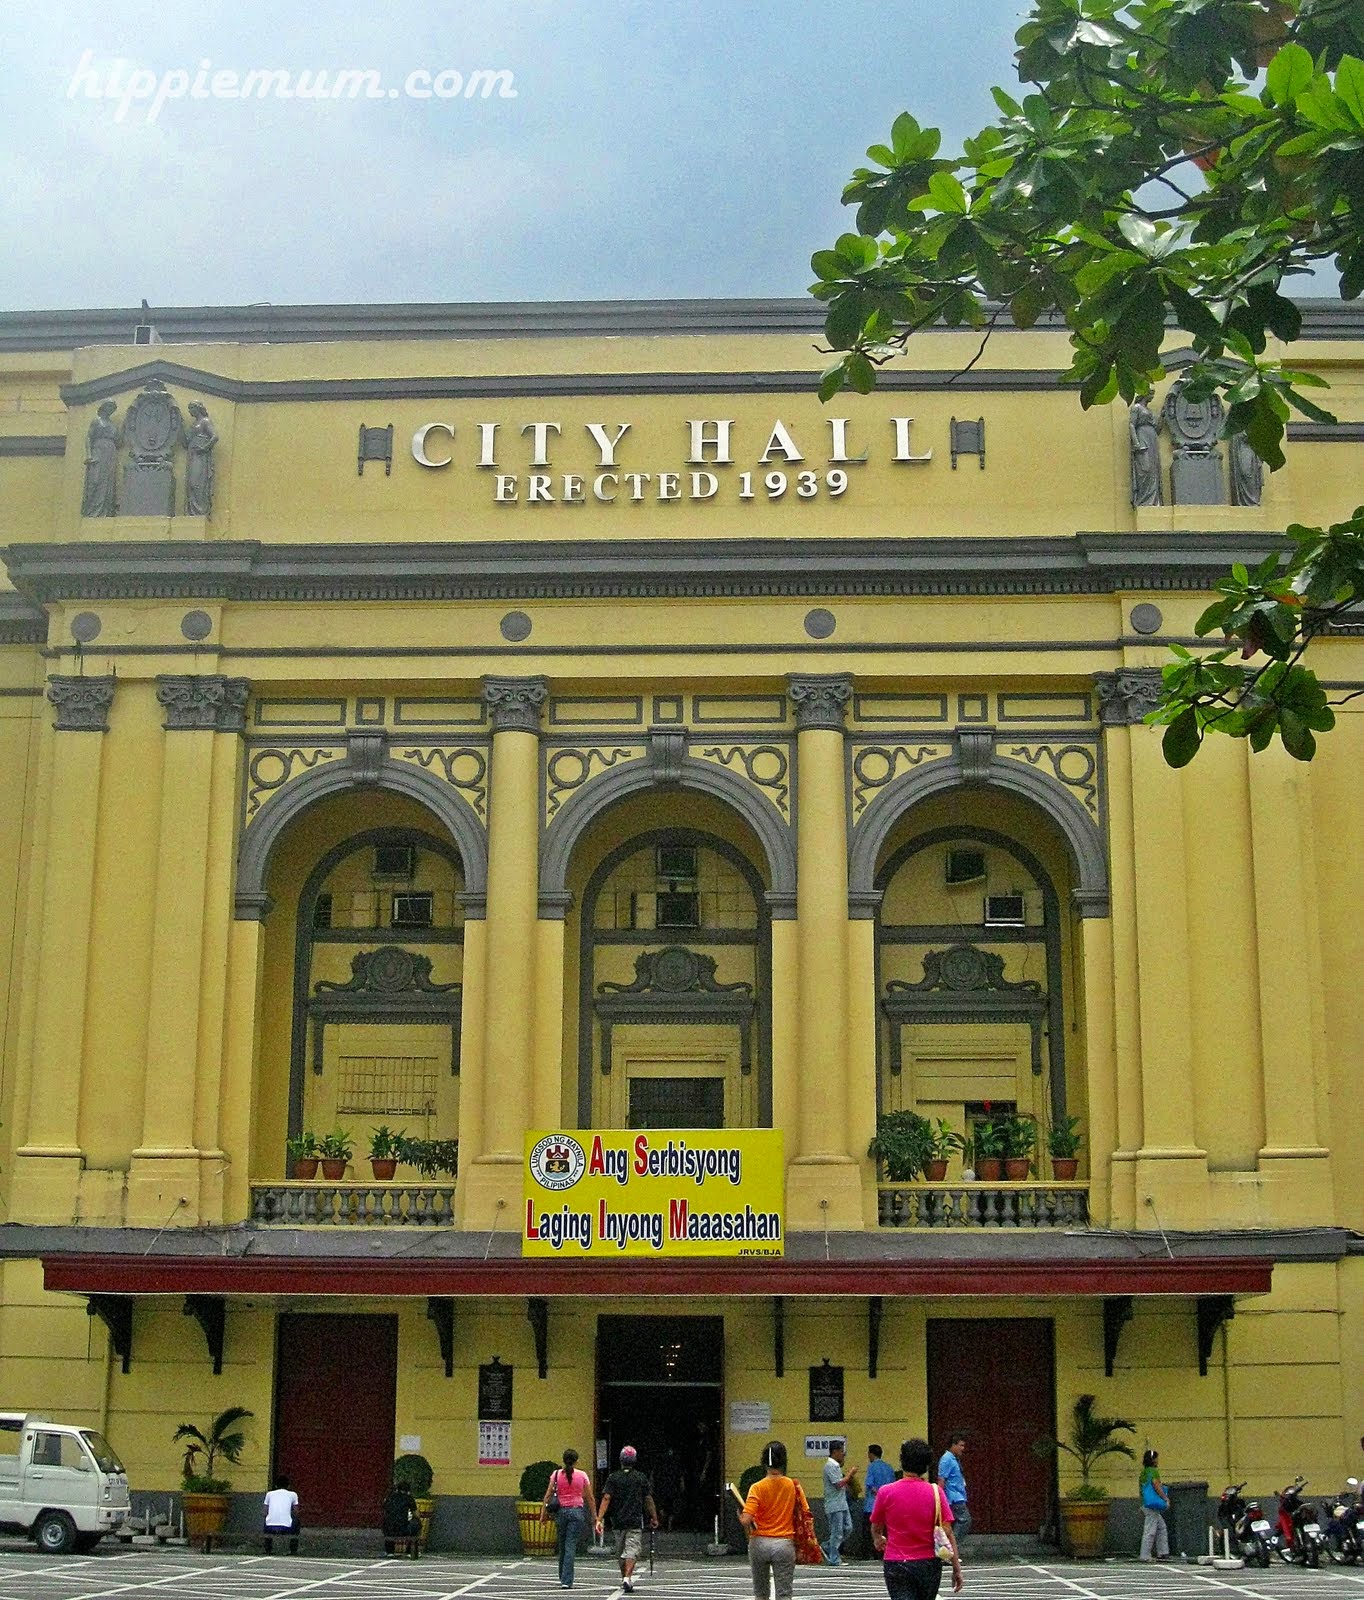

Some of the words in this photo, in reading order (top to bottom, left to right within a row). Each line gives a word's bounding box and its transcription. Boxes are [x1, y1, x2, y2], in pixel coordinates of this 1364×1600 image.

[411, 422, 632, 468] CITY
[684, 417, 933, 464] HALL
[494, 472, 719, 502] ERECTED
[739, 469, 848, 499] 1939
[531, 1137, 553, 1169] LUNGSOD
[553, 1136, 565, 1144] NG
[566, 1138, 584, 1168] MAYNILA
[589, 1135, 628, 1185] Ang
[634, 1134, 742, 1185] Serbisyong
[540, 1177, 575, 1189] PILIPINAS
[526, 1199, 592, 1250] Laging
[599, 1199, 663, 1250] Inyong
[669, 1199, 781, 1241] Maaasahan
